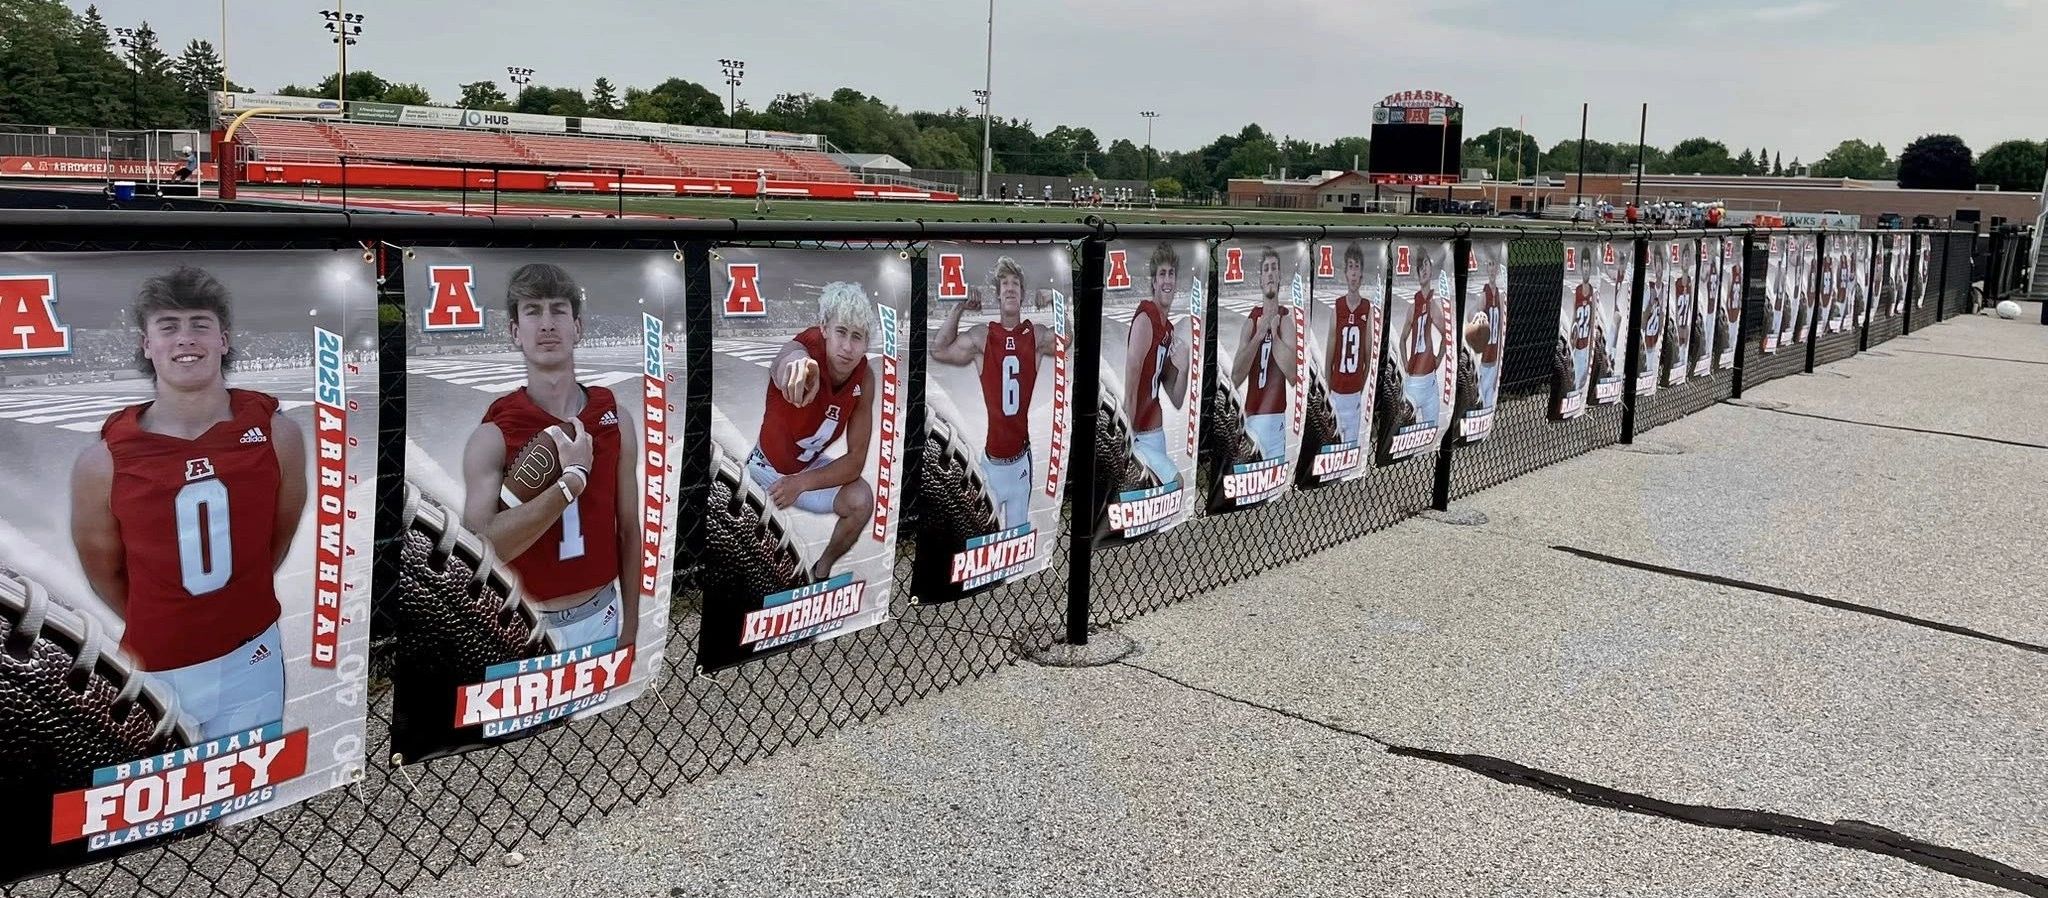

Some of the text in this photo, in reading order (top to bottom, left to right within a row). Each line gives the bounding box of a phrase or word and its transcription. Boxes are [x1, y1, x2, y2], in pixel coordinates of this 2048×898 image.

[484, 115, 509, 125] HUB
[1385, 90, 1454, 106] TARASKA
[54, 161, 115, 173] ARROWHEAD
[119, 164, 176, 175] WARHAWKS
[939, 254, 968, 299] A
[1107, 249, 1131, 289] A
[1224, 248, 1245, 283] A
[1317, 245, 1334, 278] A
[1396, 246, 1410, 275] A
[423, 264, 486, 331] A
[724, 263, 766, 316] A
[882, 306, 896, 359] 2025
[1053, 292, 1065, 338] 2025
[645, 317, 661, 378] 2025
[1005, 336, 1016, 350] A
[1339, 326, 1361, 374] 13
[1002, 355, 1020, 417] 6
[1187, 317, 1201, 453] ARROWHEAD
[1293, 307, 1304, 432] ARROWHEAD
[239, 430, 267, 444] adidas
[1047, 338, 1066, 493] ARROWHEAD
[796, 418, 839, 463] 4
[874, 359, 897, 537] ARROWHEAD
[1313, 448, 1360, 476] KUGLER
[1389, 427, 1438, 454] HUGHES
[185, 457, 215, 482] A
[642, 378, 664, 592] ARROWHEAD
[1223, 463, 1289, 499] SHUMLAS
[315, 329, 343, 663] 2025 ARROWHEAD
[341, 363, 359, 627] FOOTBALL
[1108, 490, 1183, 532] SCHNEIDER
[174, 477, 235, 597] 0
[982, 528, 1019, 546] LUKAS
[1124, 524, 1149, 539] CLASS
[951, 531, 1036, 583] PALMITER
[792, 581, 829, 600] COLE
[963, 575, 991, 591] CLASS
[994, 570, 1004, 581] OF
[741, 581, 864, 645] KETTERHAGEN
[754, 619, 843, 652] CLASS OF 2026
[518, 645, 593, 673] ETHAN
[463, 648, 629, 725] KIRLEY
[485, 690, 608, 738] CLASS OF 2026
[116, 727, 265, 780] BRENDAN
[82, 738, 287, 836] FOLEY
[91, 786, 273, 850] CLASS OF 2026
